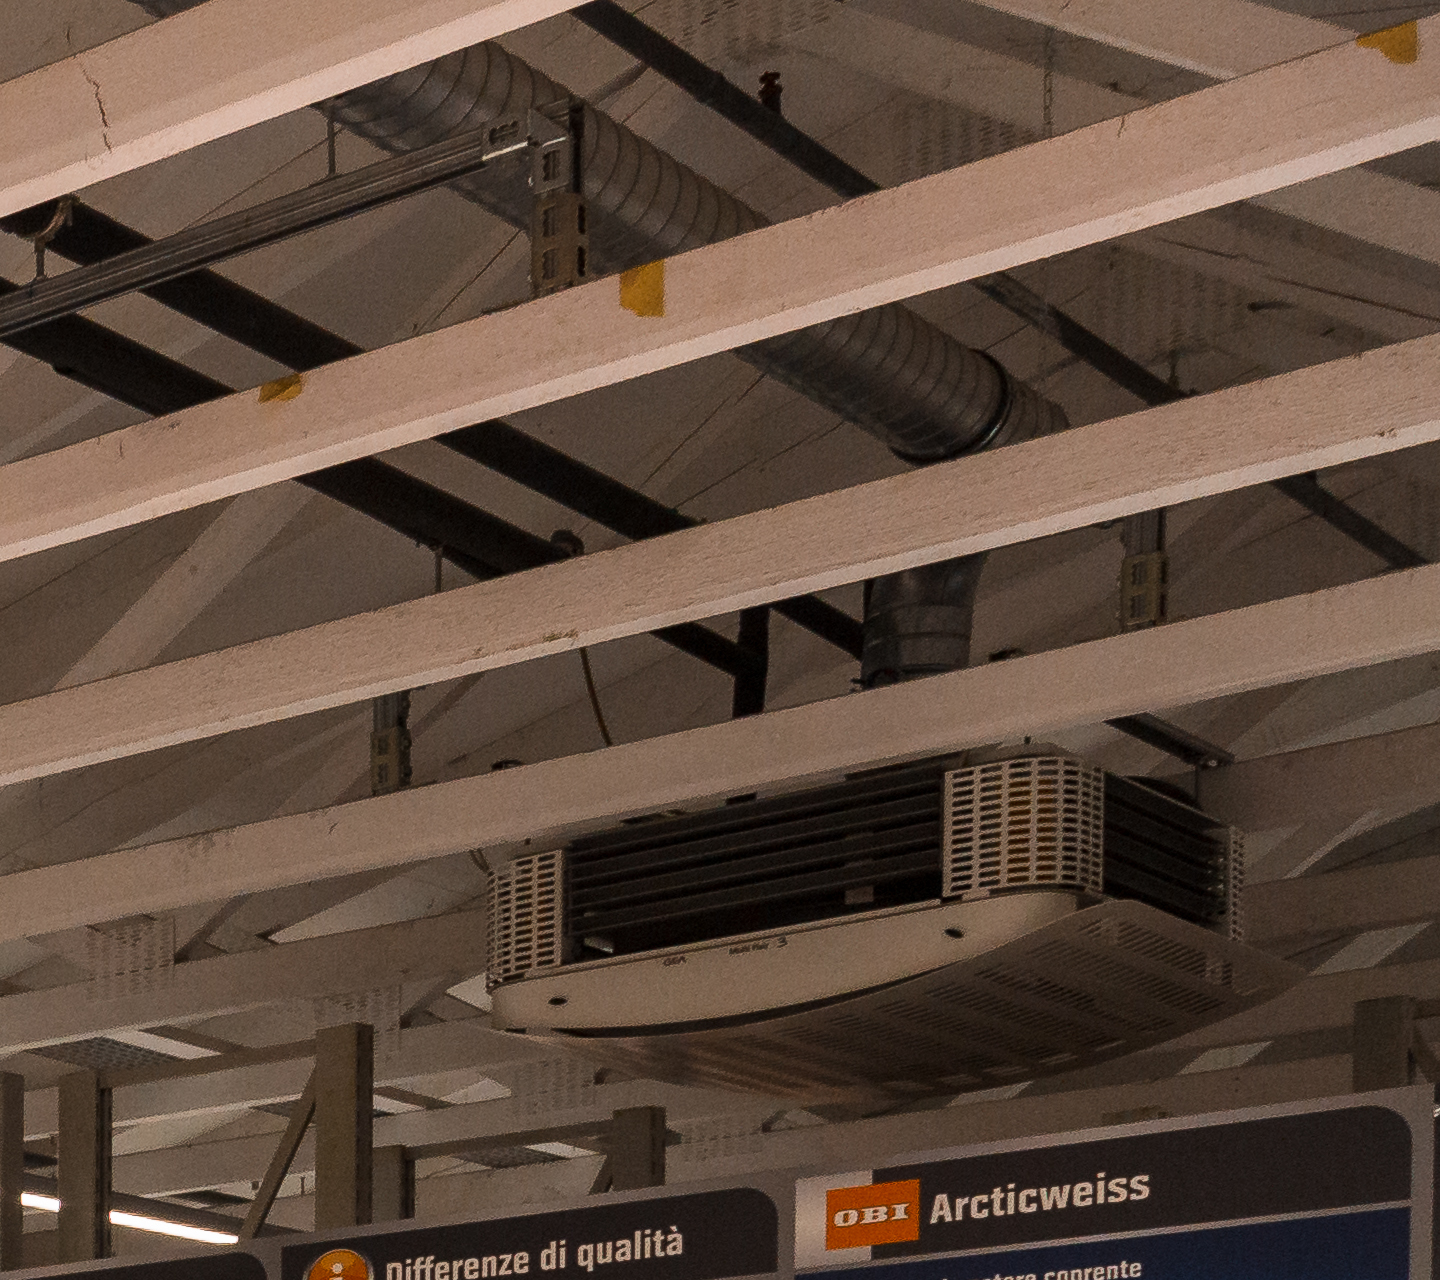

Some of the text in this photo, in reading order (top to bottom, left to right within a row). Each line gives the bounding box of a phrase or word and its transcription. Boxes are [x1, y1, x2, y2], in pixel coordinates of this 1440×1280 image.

[833, 1171, 1151, 1228] OBI Arcticweiss
[539, 1239, 568, 1271] di
[577, 1225, 684, 1272] qualità
